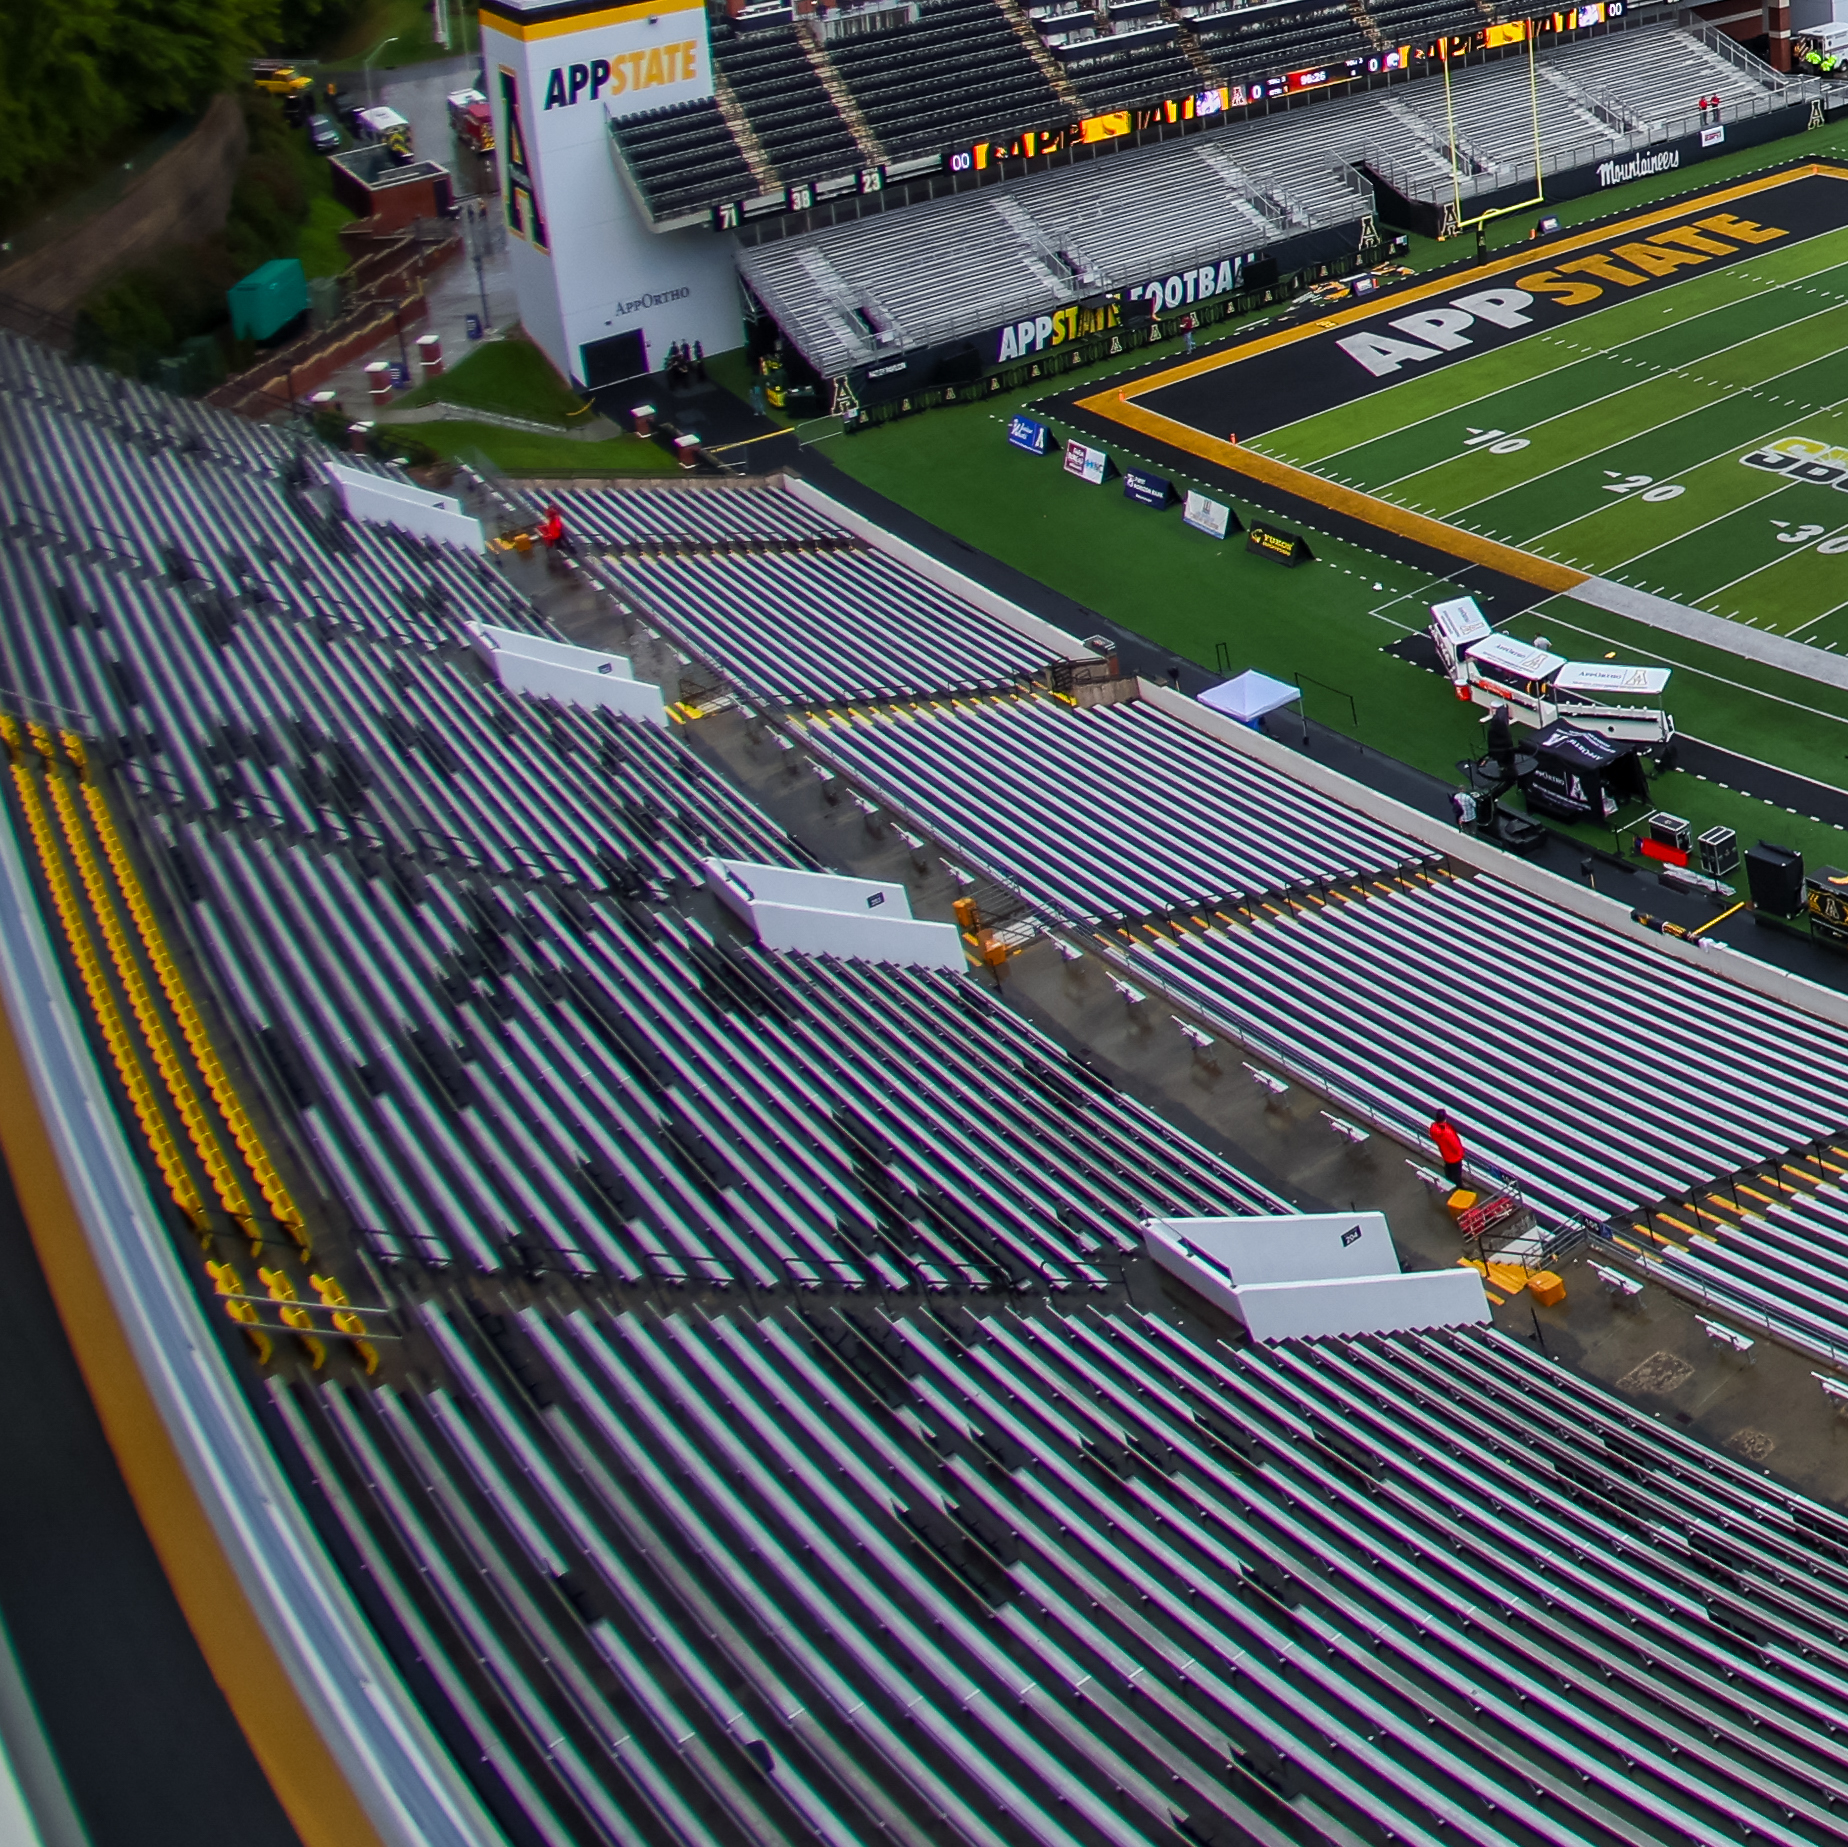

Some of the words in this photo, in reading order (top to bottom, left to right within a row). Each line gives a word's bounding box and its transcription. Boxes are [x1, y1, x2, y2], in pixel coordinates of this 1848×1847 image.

[1596, 150, 1680, 187] Mountaineers
[1462, 429, 1531, 455] 10
[1603, 474, 1687, 503] 20
